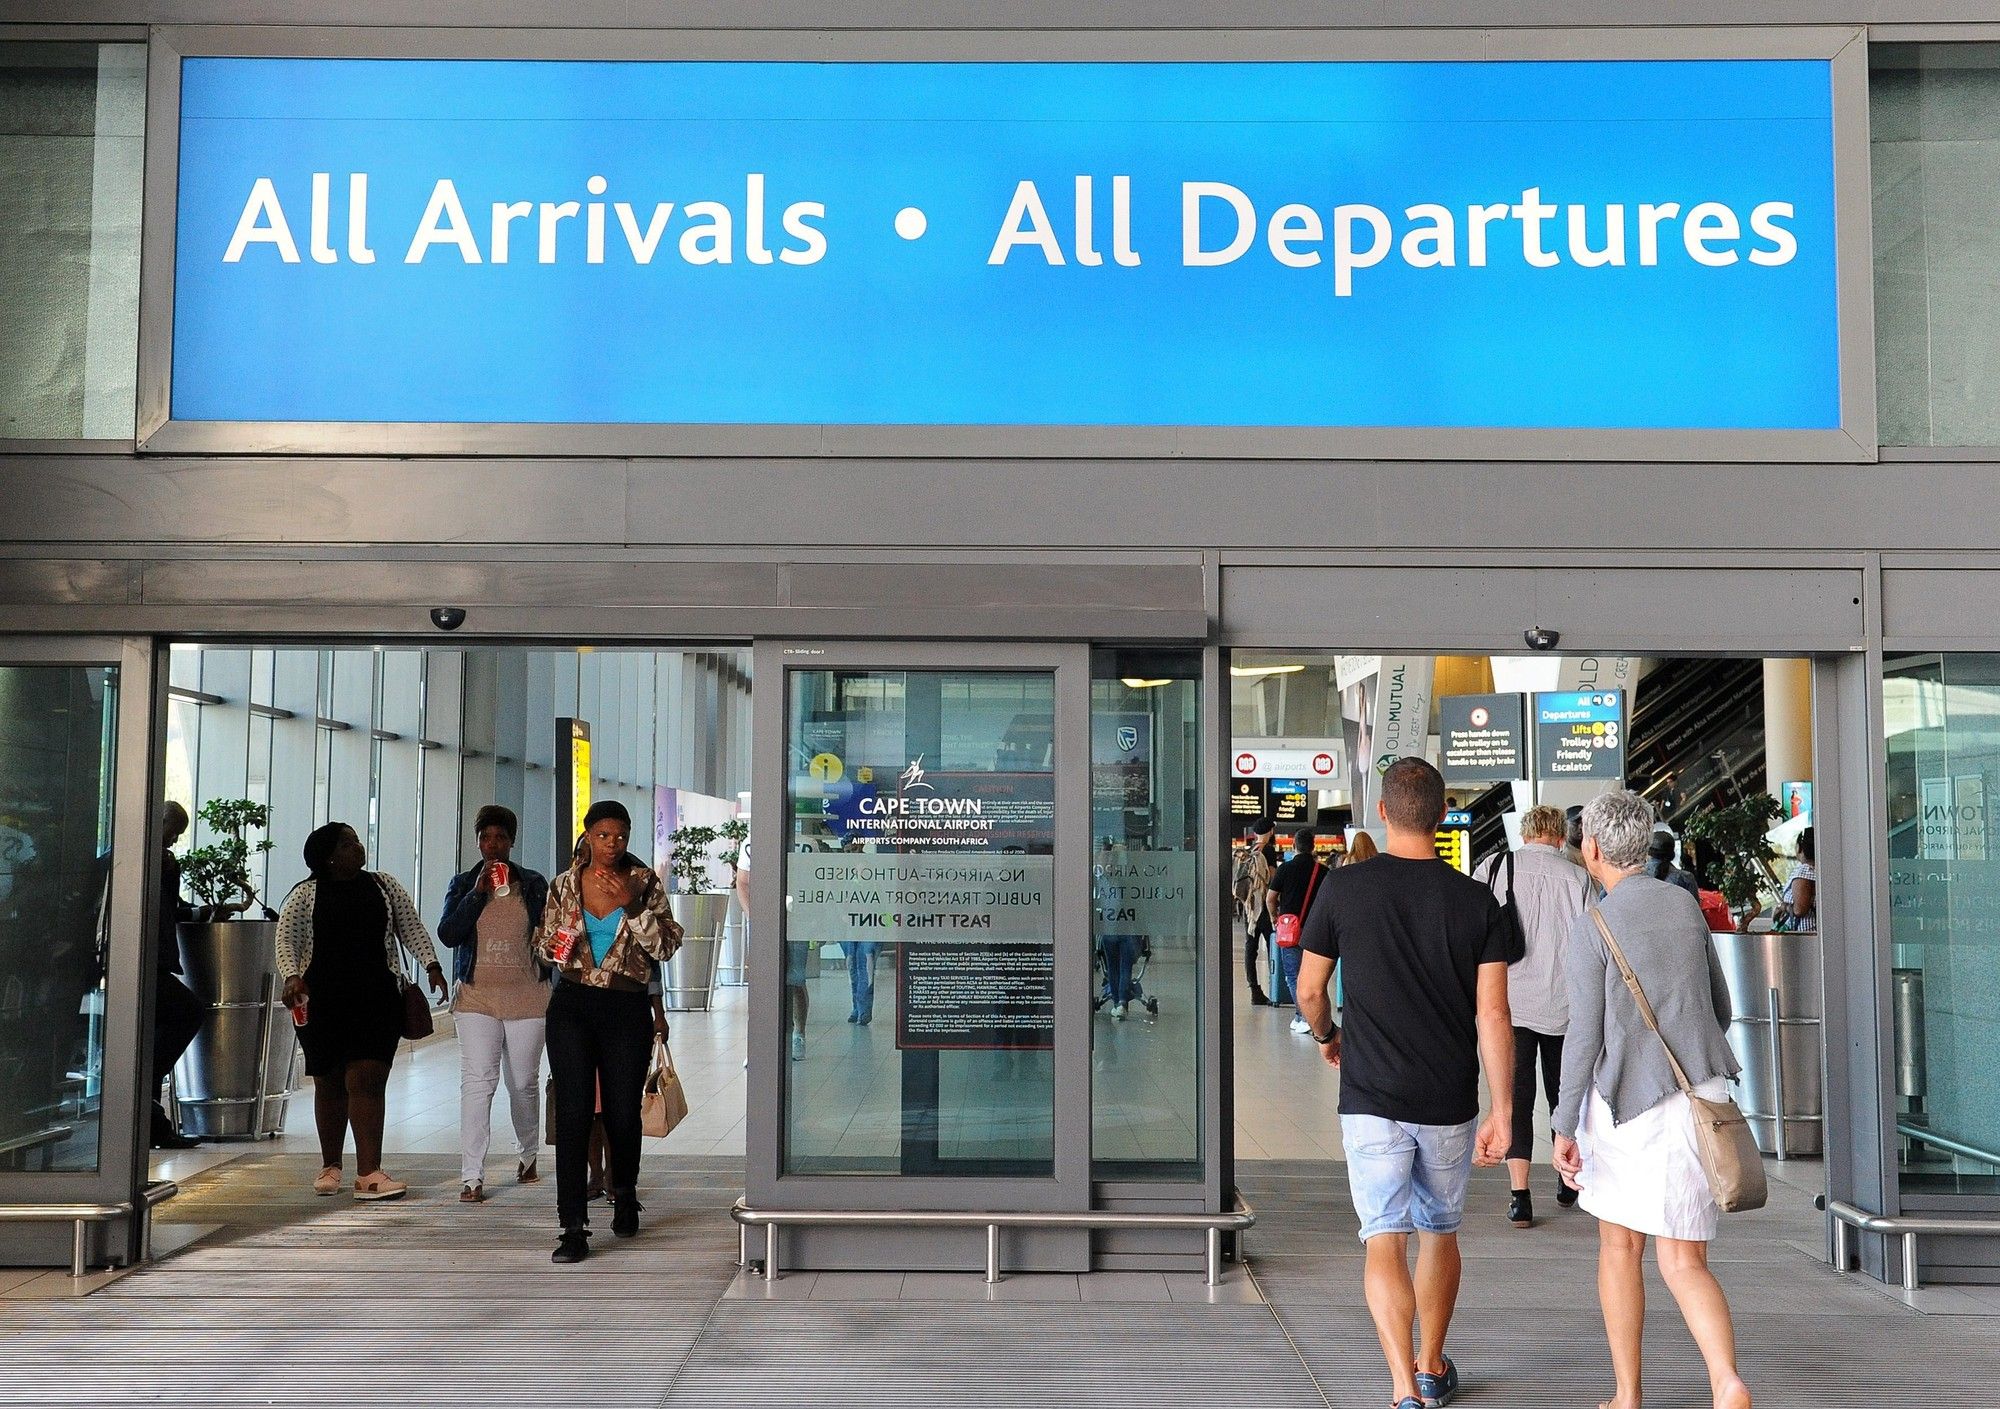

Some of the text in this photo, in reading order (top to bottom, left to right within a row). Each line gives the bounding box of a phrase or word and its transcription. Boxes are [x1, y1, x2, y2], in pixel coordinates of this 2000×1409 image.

[222, 172, 1797, 297] All Arrivals All Departures
[1542, 696, 1591, 721] All Departures
[1468, 730, 1490, 738] handle
[1491, 729, 1510, 737] down
[1572, 724, 1592, 735] Lifts
[1469, 739, 1491, 748] trolley
[1561, 737, 1592, 750] Trolley
[1446, 748, 1475, 756] escalator
[1556, 749, 1592, 761] Friendly
[1274, 762, 1306, 771] airports
[1447, 758, 1469, 766] handle
[1478, 757, 1496, 766] apply
[1551, 761, 1593, 772] Escalator
[859, 797, 910, 815] CAPE
[916, 798, 982, 815] TOWN
[846, 818, 995, 830] INTERNATIONAL AIRPORT
[851, 837, 989, 845] AIRPORTS COMPANY SOUTH AFRICA
